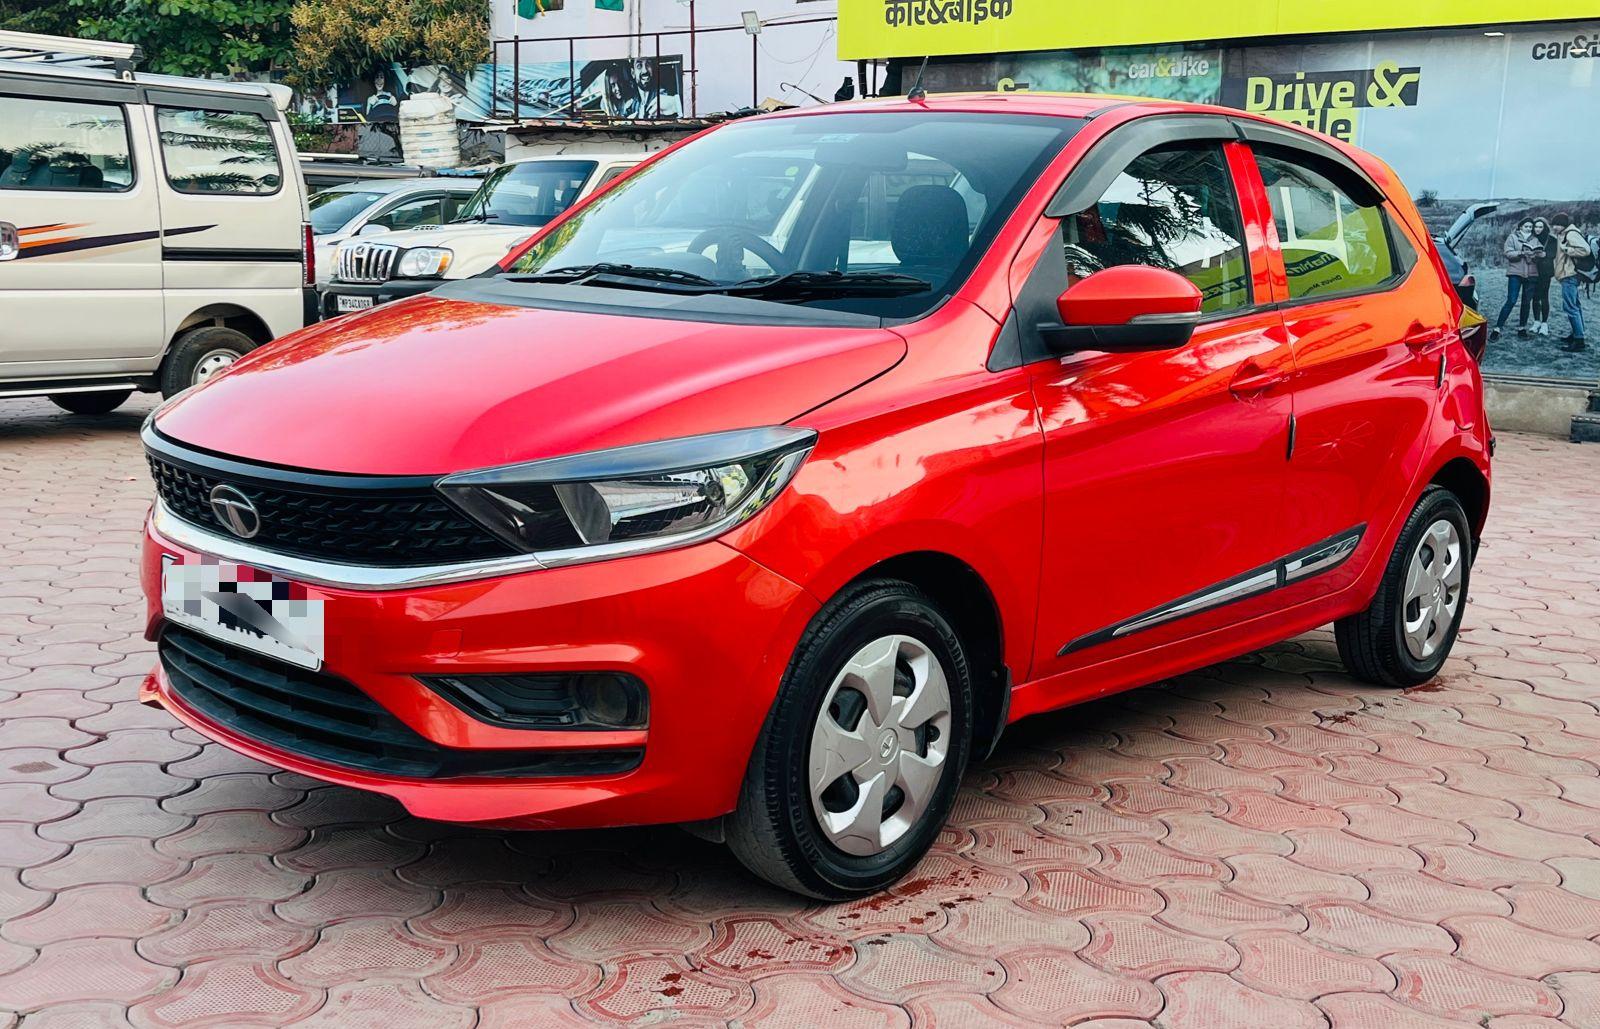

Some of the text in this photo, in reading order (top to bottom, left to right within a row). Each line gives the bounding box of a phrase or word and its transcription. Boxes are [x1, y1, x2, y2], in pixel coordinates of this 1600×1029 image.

[1128, 56, 1209, 79] car&bike
[1246, 59, 1421, 112] Drive &
